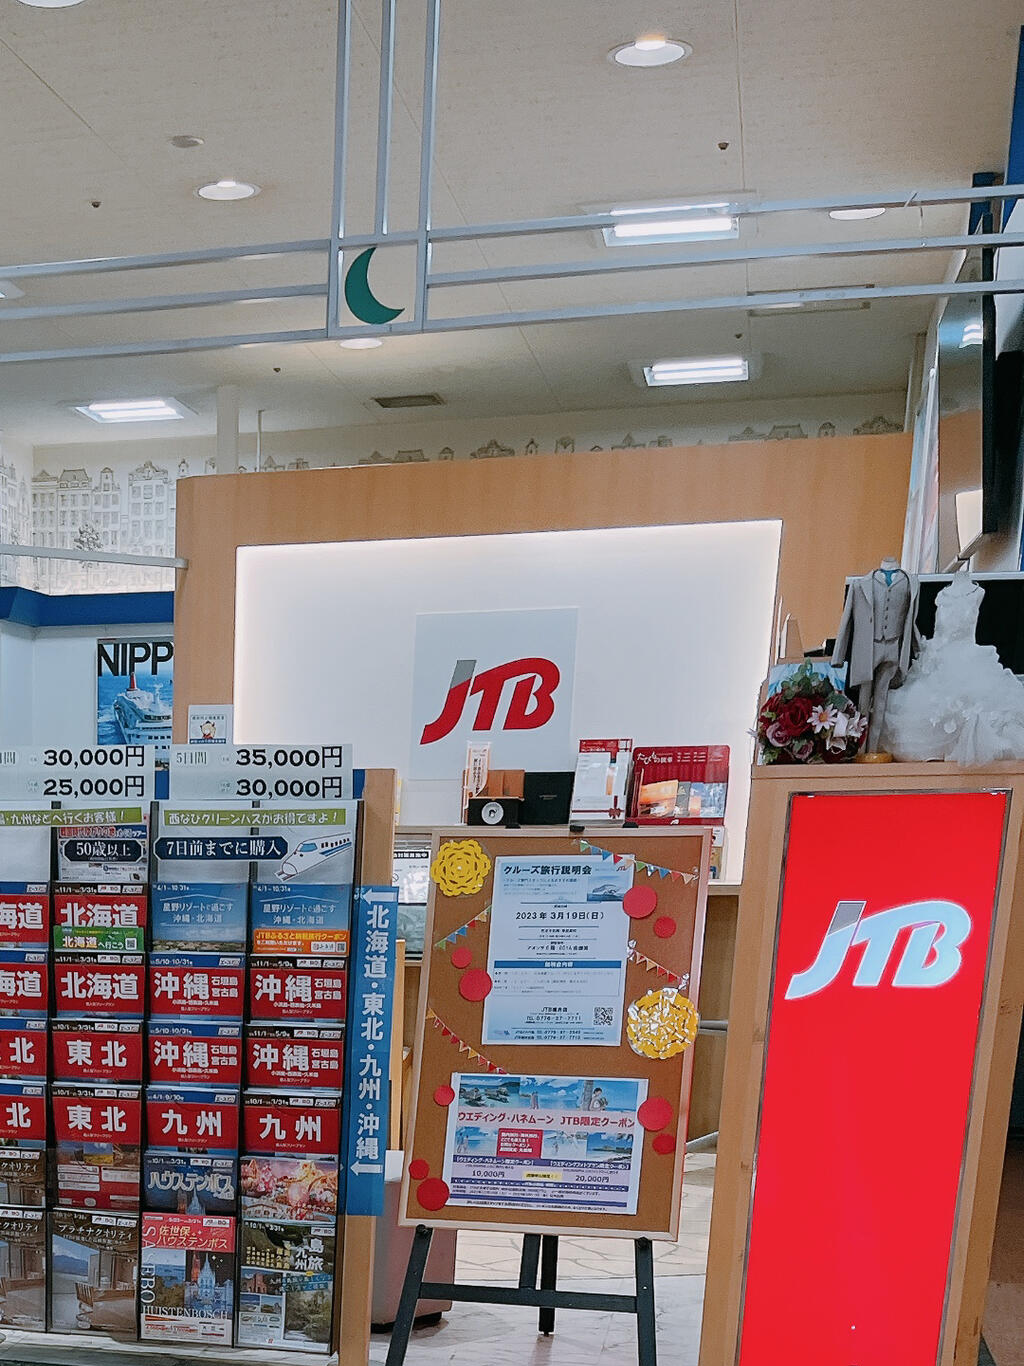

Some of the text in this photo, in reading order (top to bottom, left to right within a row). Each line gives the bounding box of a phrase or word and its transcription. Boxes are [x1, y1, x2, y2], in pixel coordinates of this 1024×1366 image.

[97, 641, 174, 677] NIPP
[420, 657, 560, 745] JTB
[43, 745, 145, 769] 30,000円
[236, 746, 342, 769] 35,000円
[43, 775, 145, 799] 25,000円
[236, 776, 342, 799] 30,000円
[76, 841, 132, 857] 50歳以上
[166, 840, 281, 856] 7日前までに購入
[503, 864, 593, 876] クルーズ旅行説明会
[60, 902, 139, 928] 北海道
[784, 900, 972, 1000] JTB
[60, 971, 139, 999] 北海道
[154, 971, 210, 1000] 沖縄
[254, 974, 312, 1002] 沖縄
[355, 904, 390, 1160] 北海道・東北・九州・沖縄
[66, 1039, 127, 1067] 東北
[153, 1040, 209, 1068] 沖縄
[253, 1044, 309, 1071] 沖縄
[66, 1105, 126, 1132] 東北
[161, 1109, 222, 1137] 九州
[259, 1114, 322, 1142] 九州
[458, 1111, 635, 1128] ウエディング・ハネムーン JTB限定クーポン
[471, 1170, 609, 1183] 10,000円 20,000円
[59, 1224, 133, 1241] プラチナクオリティ
[156, 1236, 228, 1249] ハウステンボス
[159, 1225, 190, 1236] 佐世保
